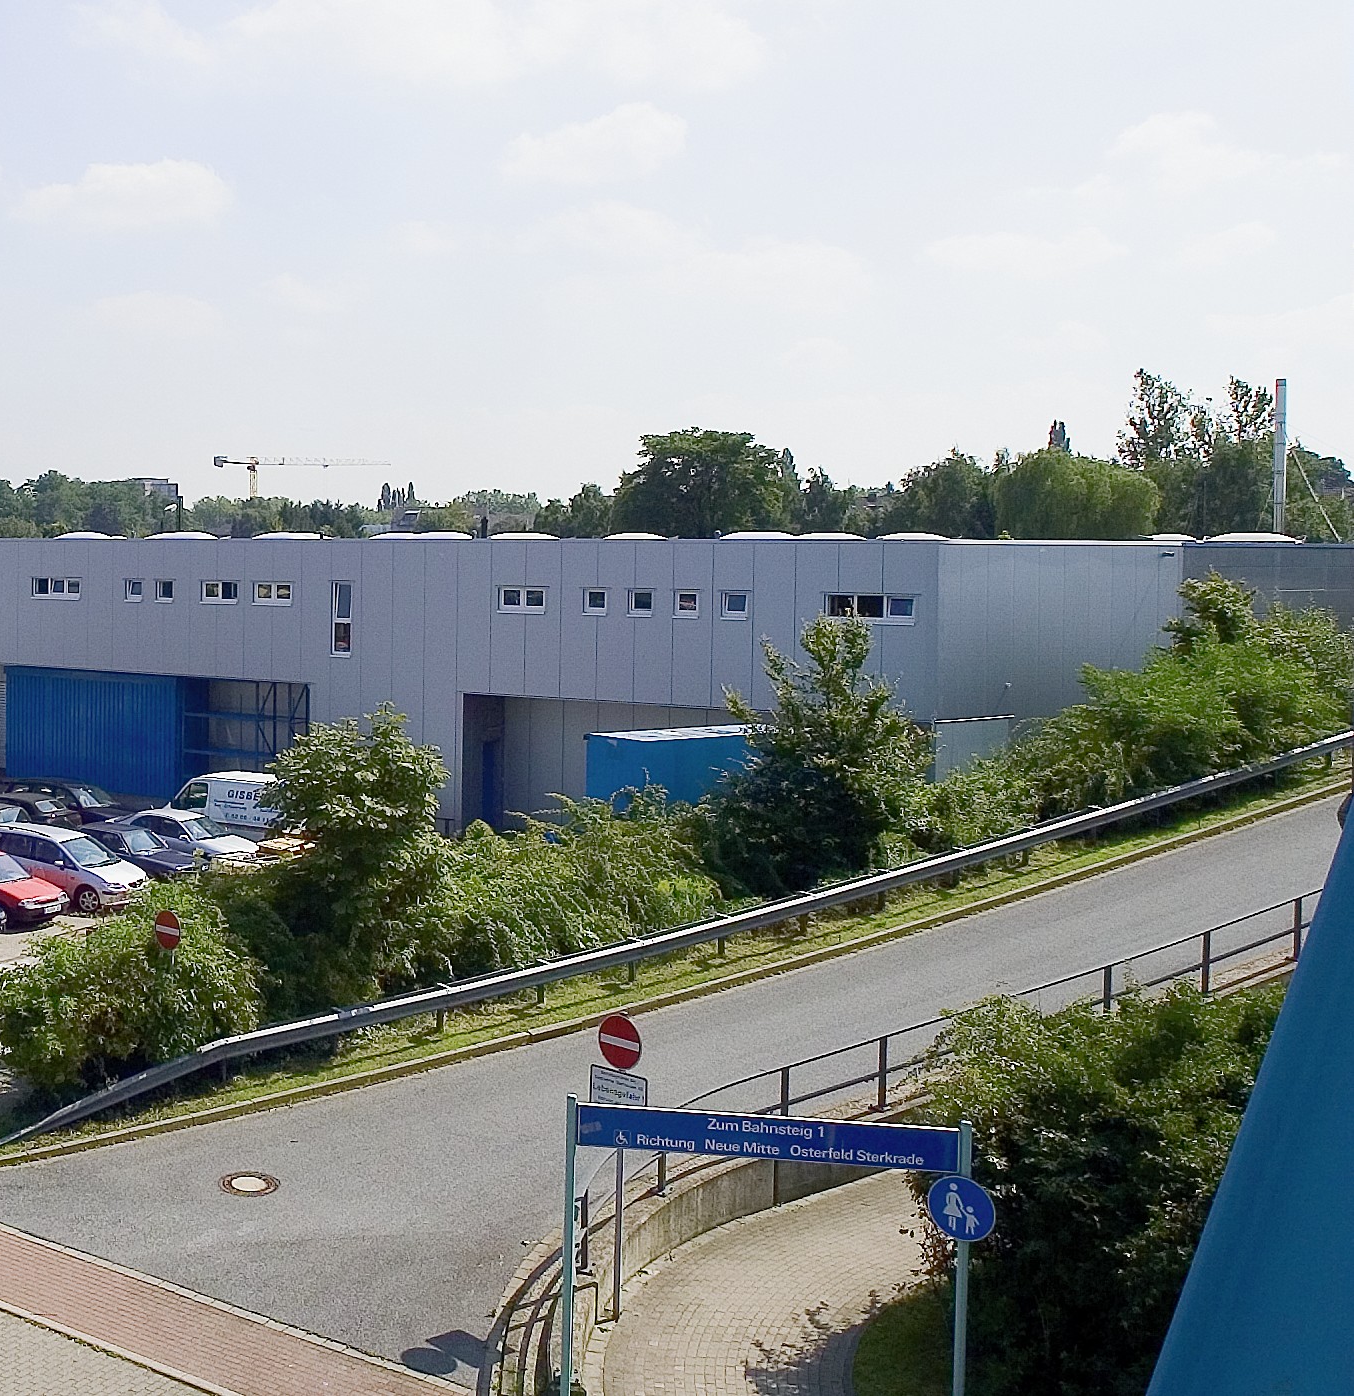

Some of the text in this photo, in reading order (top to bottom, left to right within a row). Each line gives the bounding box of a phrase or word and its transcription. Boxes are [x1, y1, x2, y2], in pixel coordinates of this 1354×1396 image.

[227, 789, 259, 801] GISBE
[707, 1118, 824, 1140] Zum Bahnsteig 1
[637, 1134, 924, 1165] Richtung Neue Mitte Osterfeld Sterkrade
